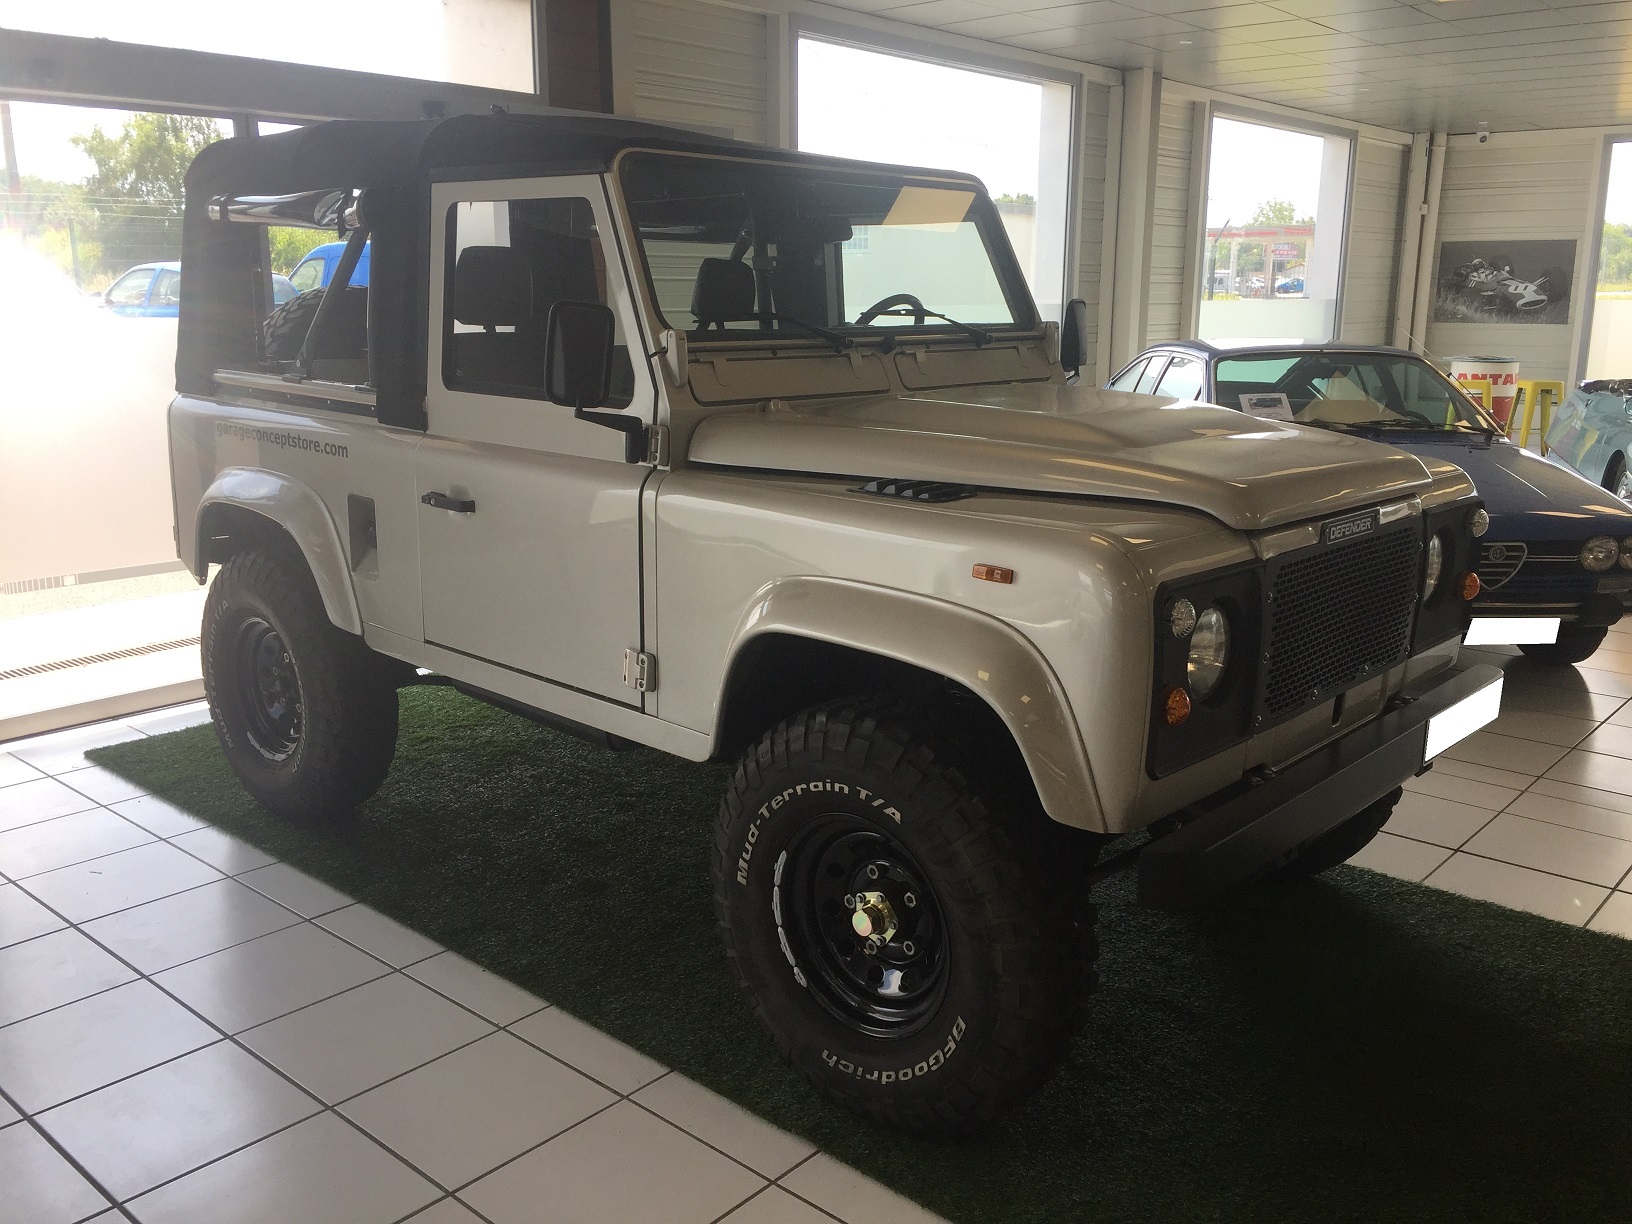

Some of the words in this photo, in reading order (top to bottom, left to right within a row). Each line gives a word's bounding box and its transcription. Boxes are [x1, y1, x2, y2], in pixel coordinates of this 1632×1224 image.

[217, 421, 349, 458] garageconceptstore.com
[1330, 518, 1372, 540] DEFENDER
[736, 779, 849, 886] Mud-Terrain
[856, 786, 901, 825] T/A
[822, 1015, 967, 1085] BFGoodrich
